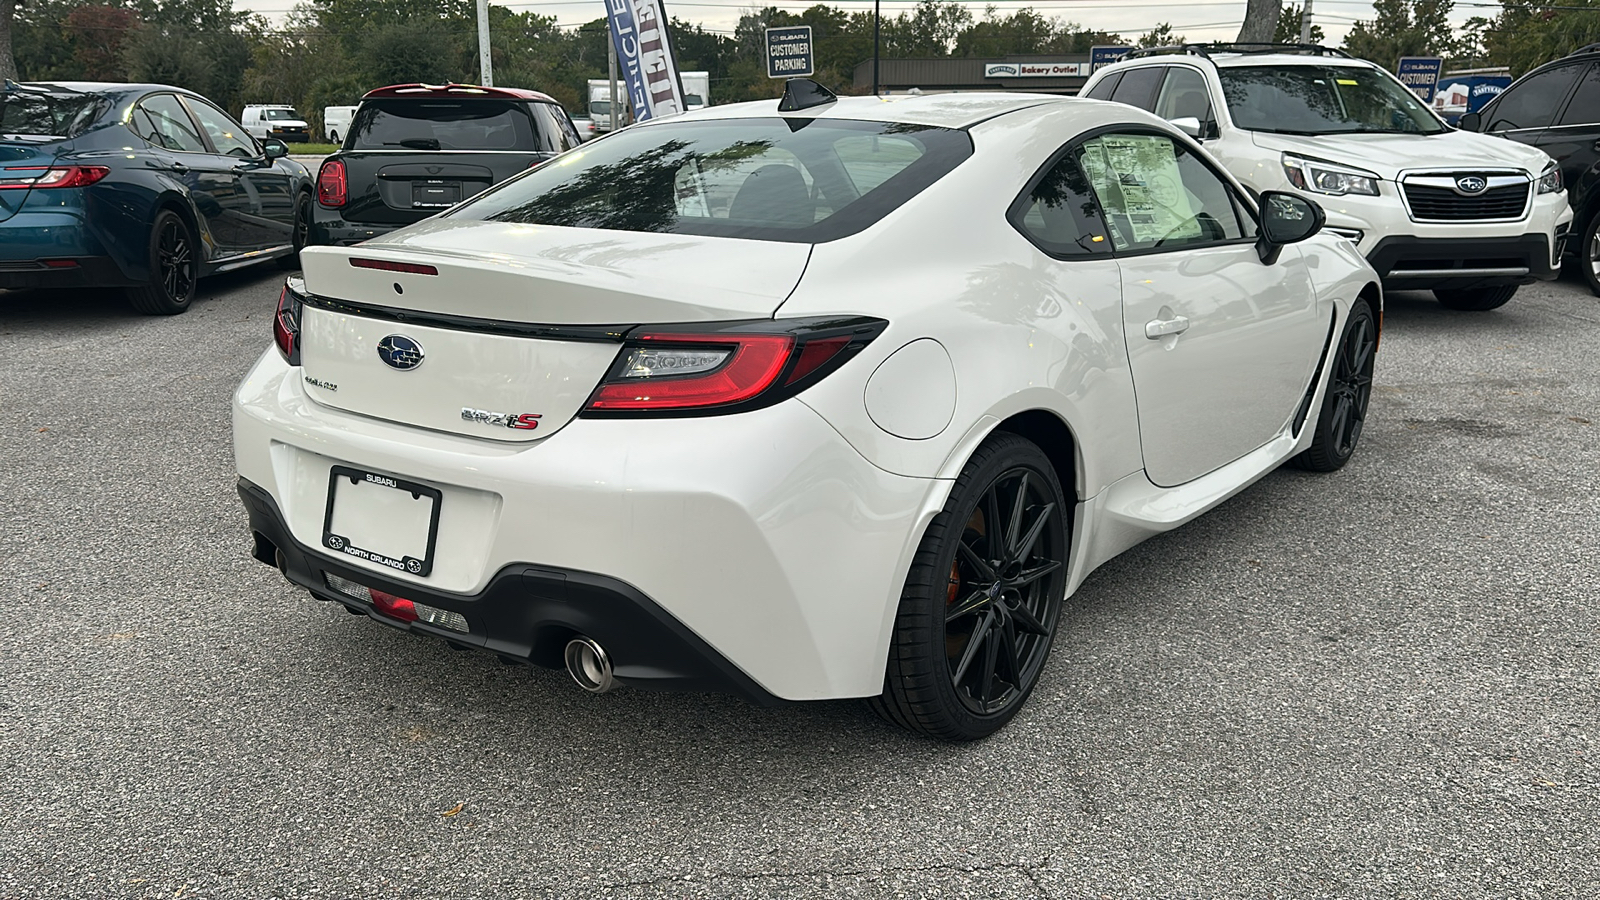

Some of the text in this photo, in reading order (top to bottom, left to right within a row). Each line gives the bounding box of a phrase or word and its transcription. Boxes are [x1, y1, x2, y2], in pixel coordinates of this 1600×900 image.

[770, 42, 809, 57] CUSTOMER
[774, 57, 807, 71] PARKING
[1021, 65, 1078, 76] Bakery Outlet
[1400, 73, 1436, 85] CUSTOMER
[366, 473, 397, 488] SUBARU
[344, 546, 405, 570] NORTH ORLANDO
